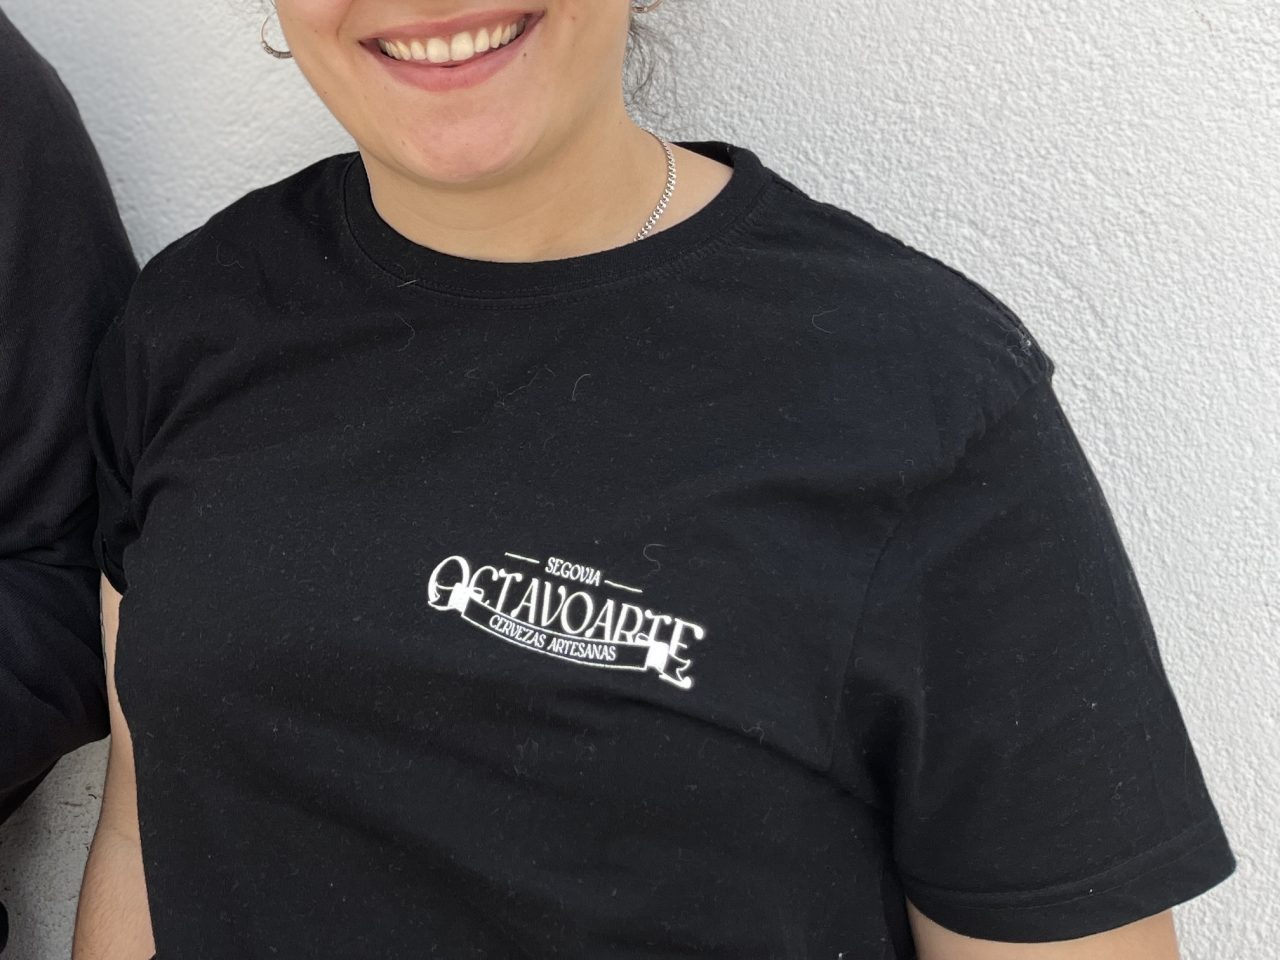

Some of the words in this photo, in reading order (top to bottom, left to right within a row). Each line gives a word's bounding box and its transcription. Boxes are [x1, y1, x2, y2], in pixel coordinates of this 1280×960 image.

[545, 556, 601, 587] SEGOVIA
[427, 555, 705, 690] OCTAVOARTE
[488, 613, 547, 649] CERVEZAS
[547, 636, 617, 662] ARTESANAS
